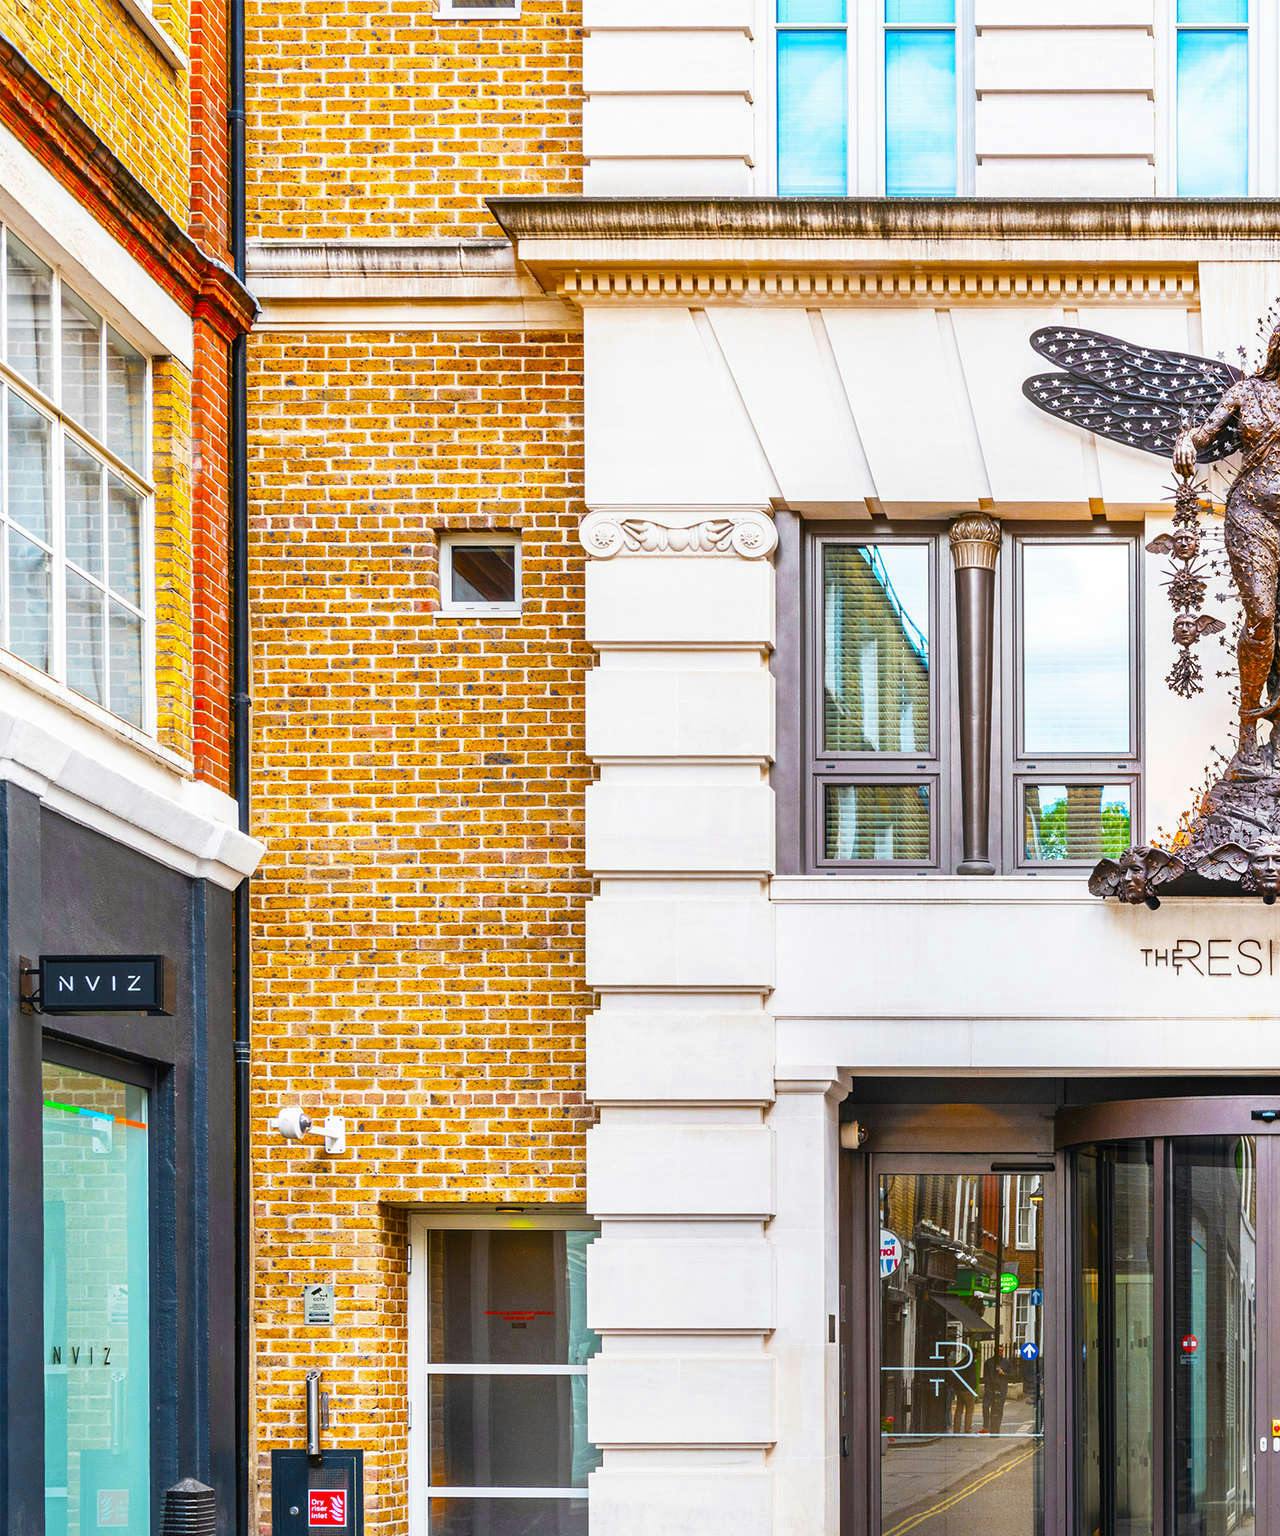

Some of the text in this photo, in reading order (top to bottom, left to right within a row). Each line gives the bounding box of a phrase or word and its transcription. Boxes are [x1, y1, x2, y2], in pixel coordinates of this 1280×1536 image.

[1140, 949, 1183, 967] THE
[59, 975, 142, 992] NVIZ
[53, 1346, 111, 1366] NVIZ
[311, 1499, 325, 1507] Dry
